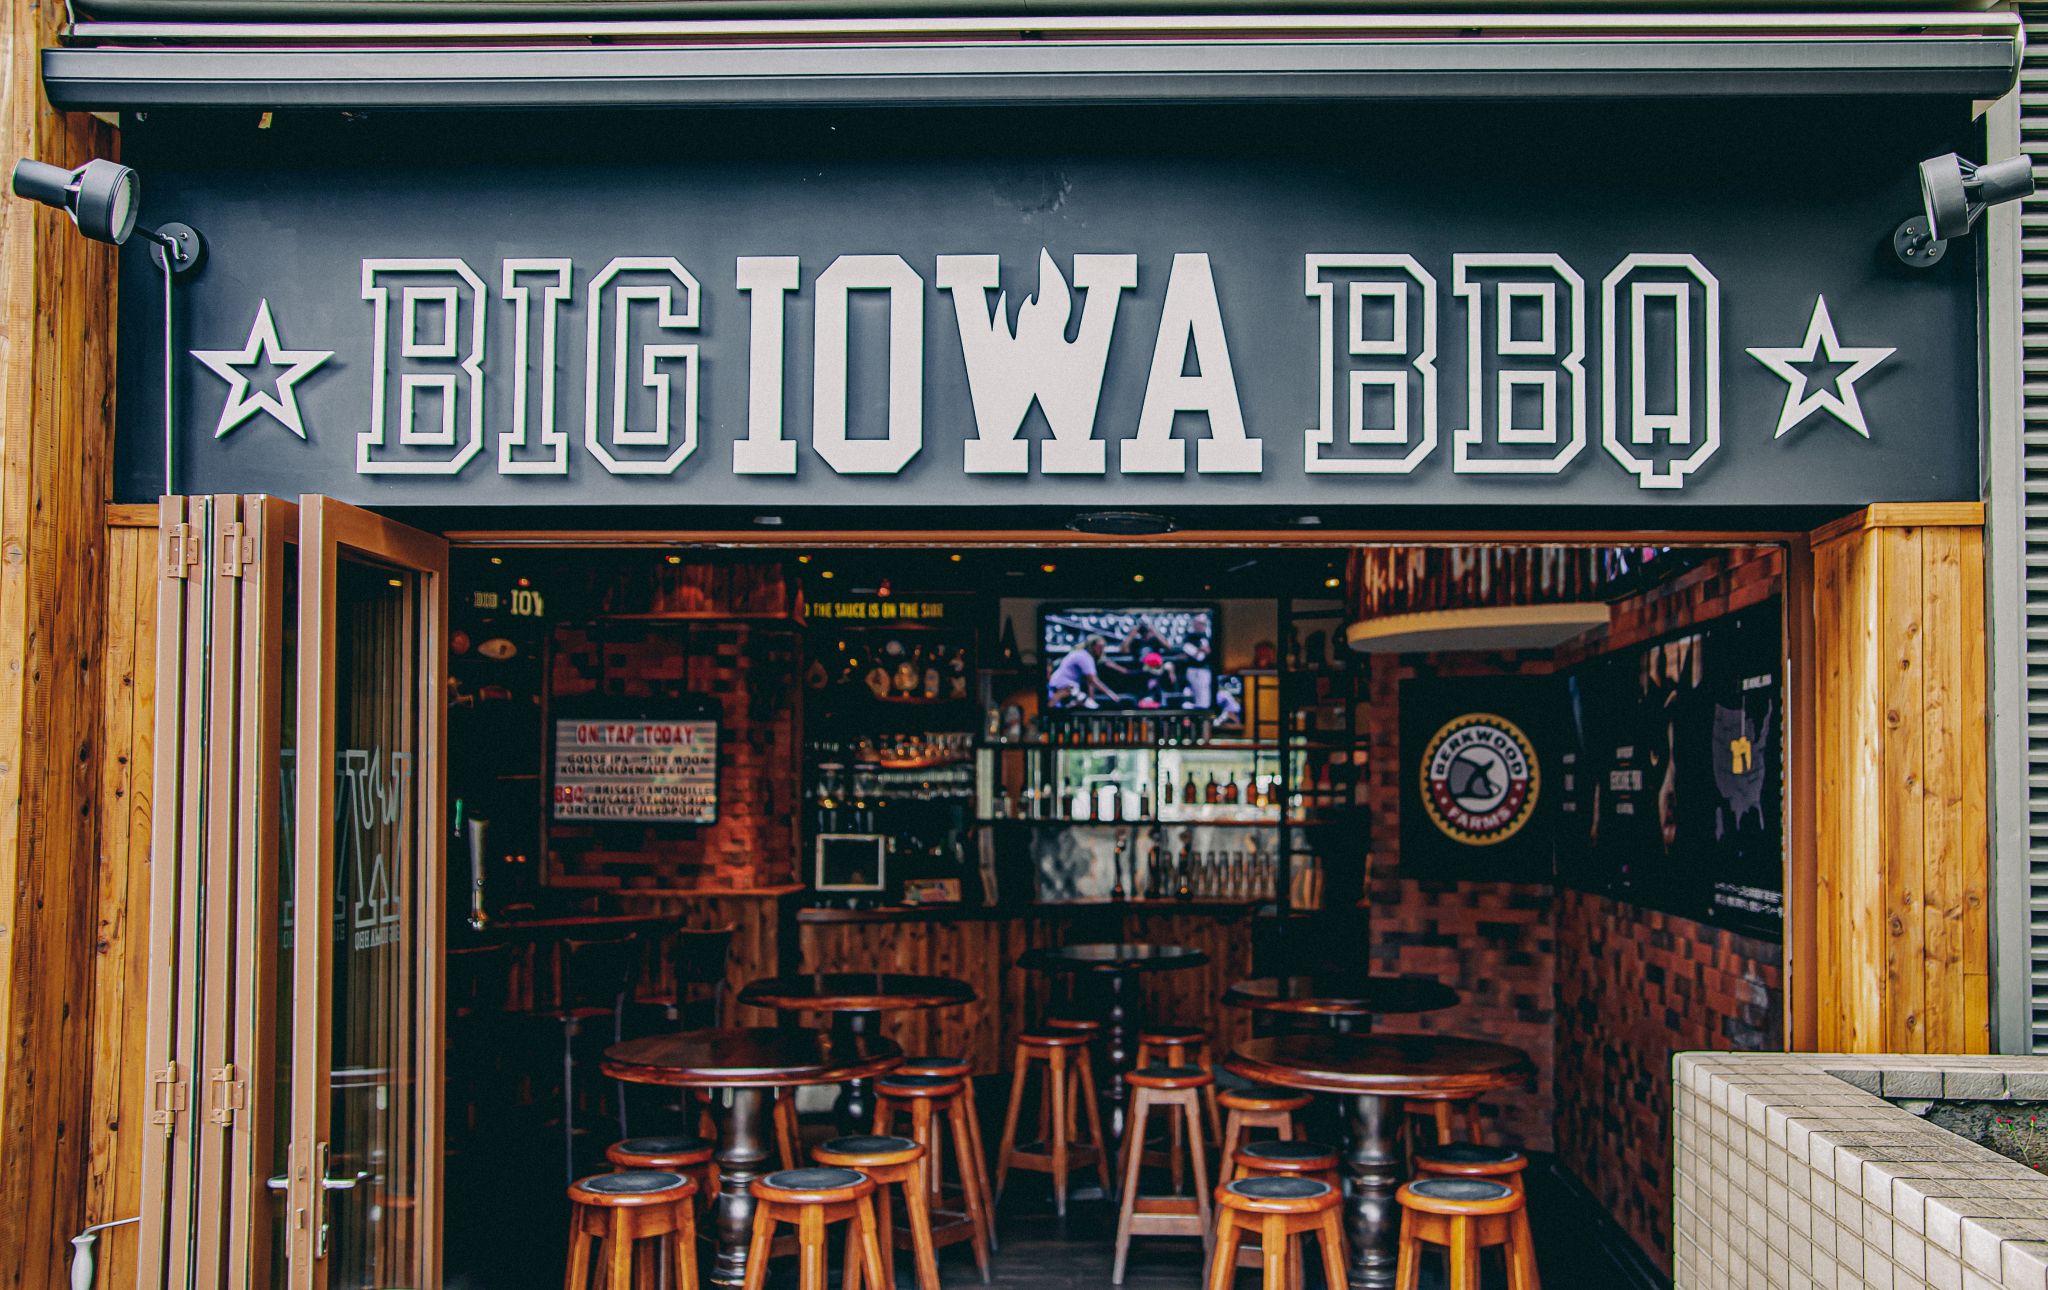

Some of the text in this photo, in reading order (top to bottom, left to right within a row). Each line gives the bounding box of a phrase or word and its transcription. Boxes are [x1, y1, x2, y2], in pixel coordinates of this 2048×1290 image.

[356, 246, 1720, 488] BIG IOWA BBQ
[813, 602, 832, 618] THE
[834, 602, 867, 618] SAUCE
[868, 602, 879, 618] IS
[899, 602, 919, 618] THE
[577, 724, 696, 744] ON TAP TODAY
[1434, 729, 1523, 776] BERKWOOD
[1447, 806, 1512, 829] FARMS
